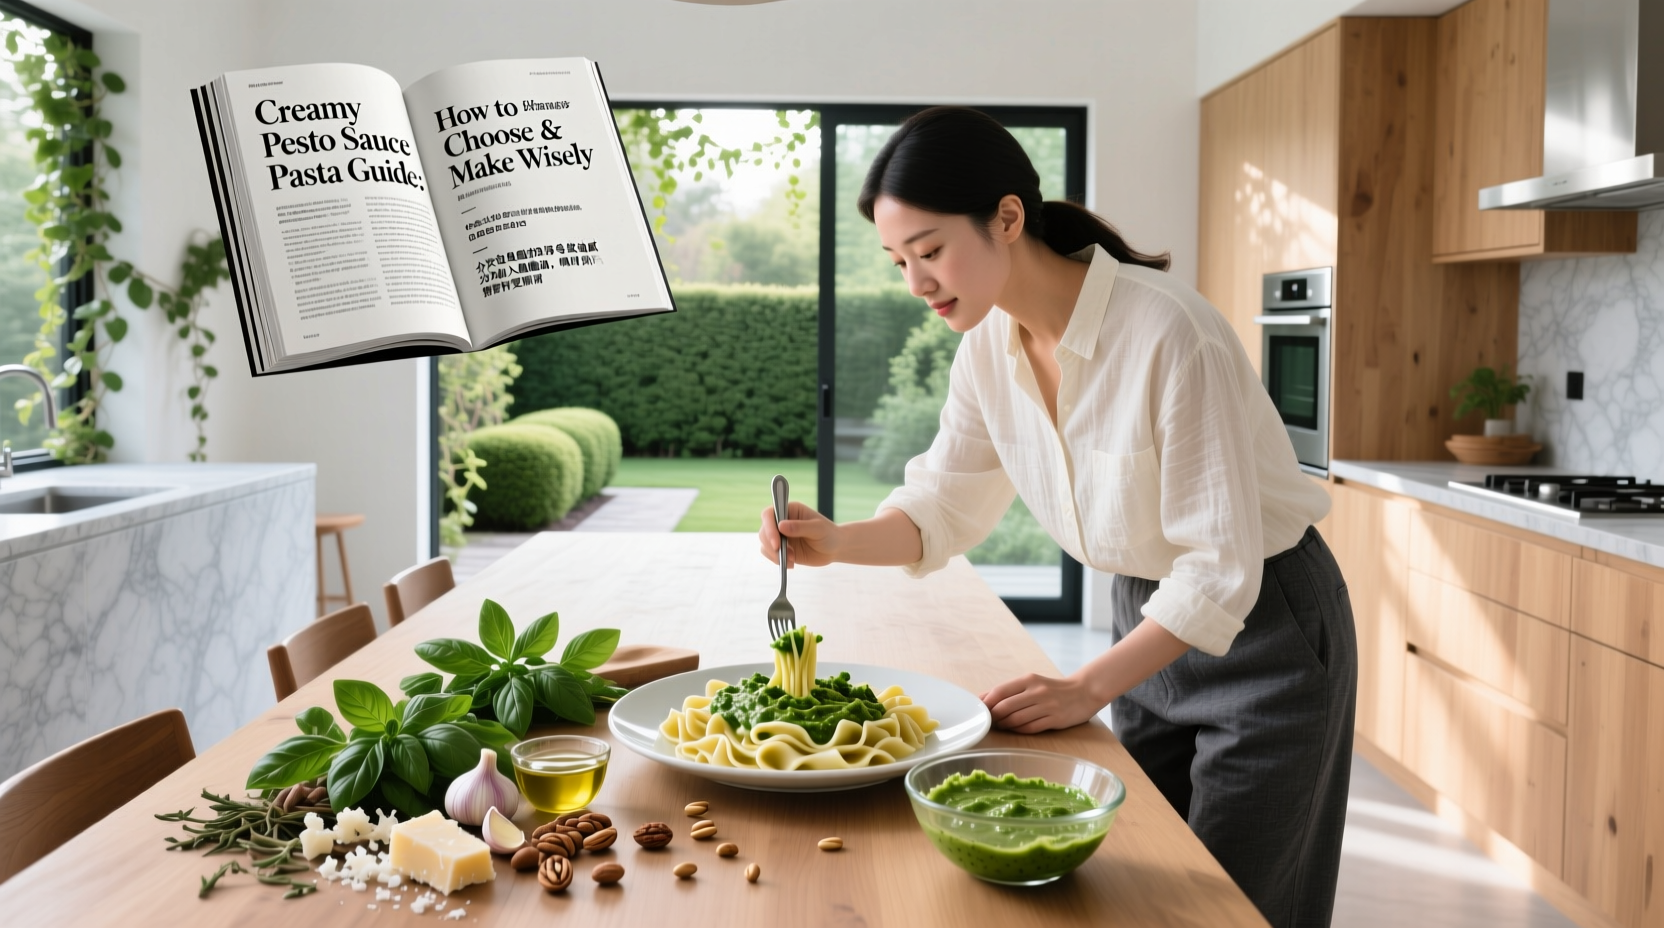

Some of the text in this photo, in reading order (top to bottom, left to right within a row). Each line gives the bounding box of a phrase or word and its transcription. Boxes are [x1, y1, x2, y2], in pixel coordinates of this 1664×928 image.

[255, 99, 361, 126] Creamy
[433, 104, 489, 133] How
[494, 99, 518, 118] to
[259, 126, 411, 158] Pesto Sauce
[443, 119, 562, 158] Choose &
[266, 162, 344, 191] Pasta
[447, 142, 593, 190] Make Wisely
